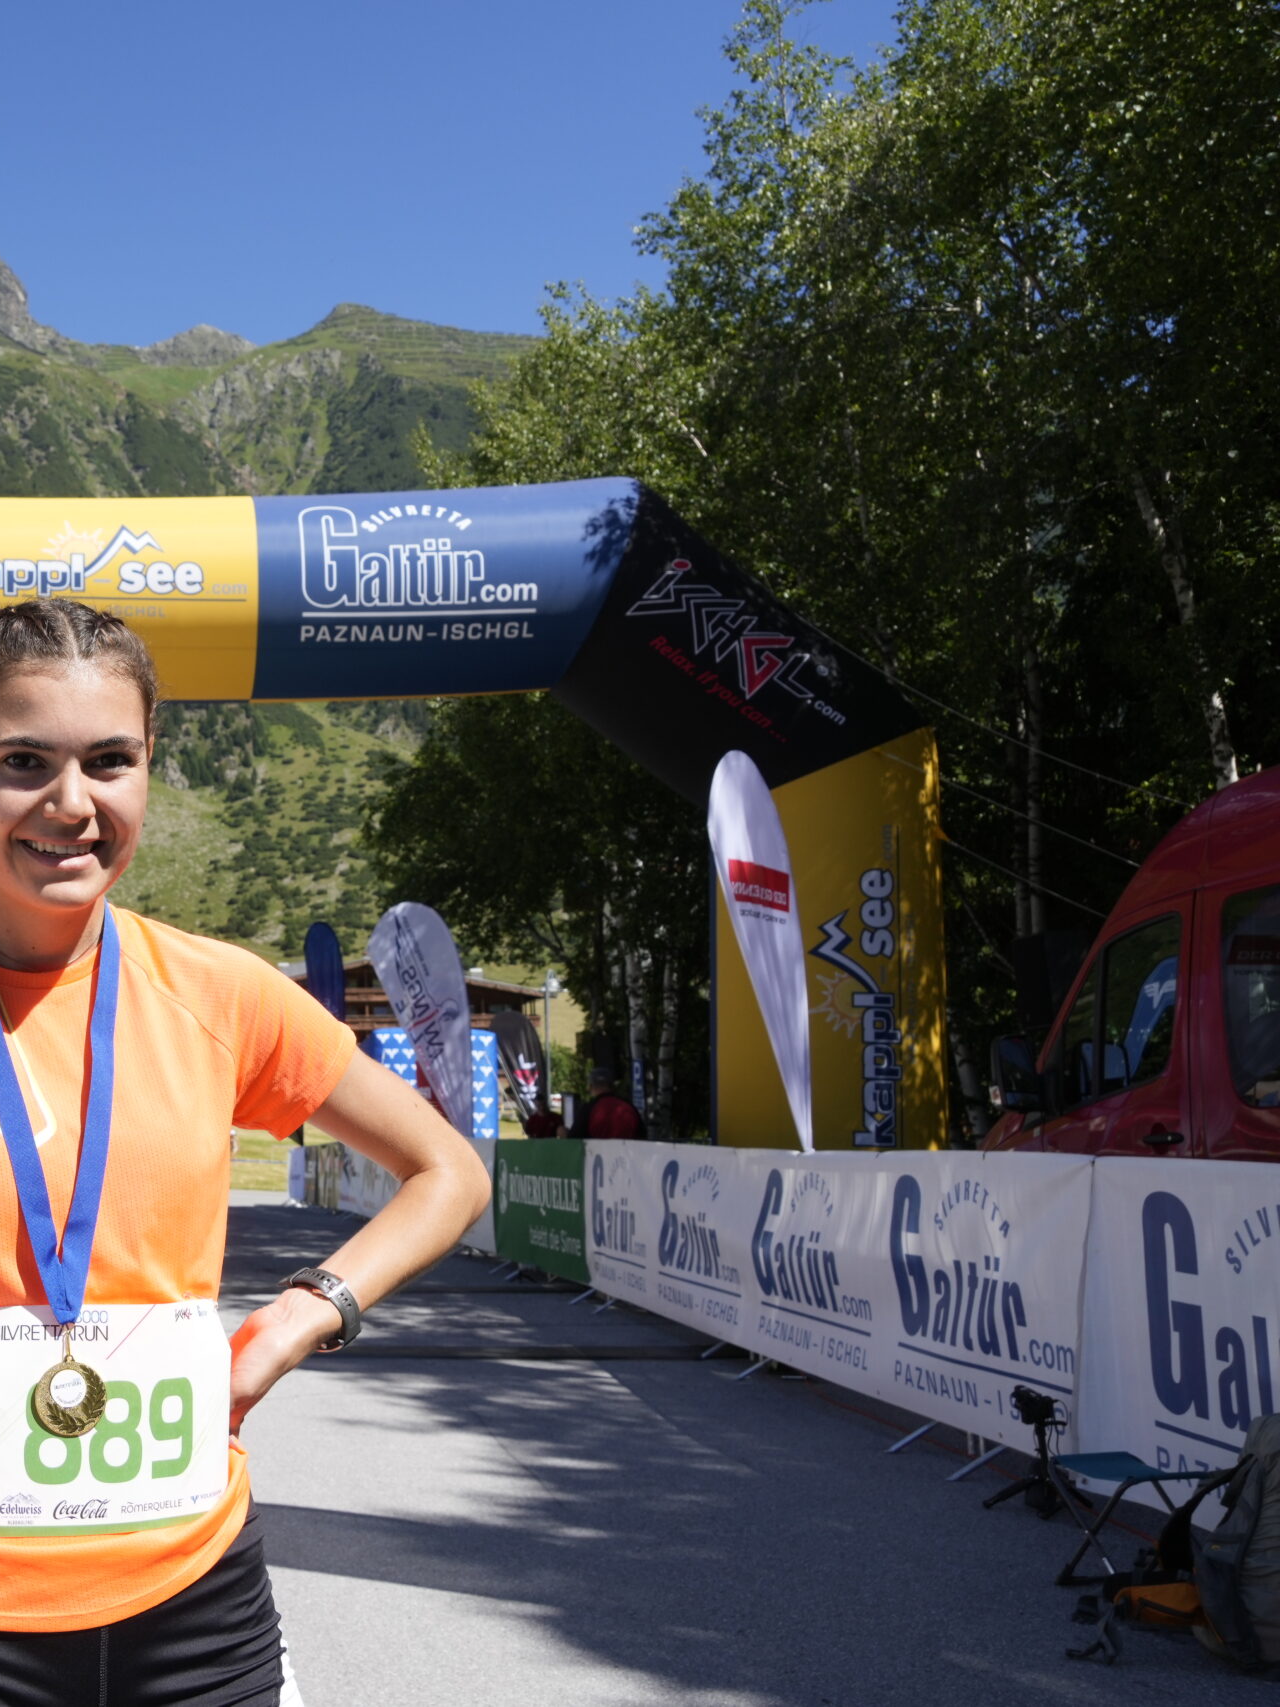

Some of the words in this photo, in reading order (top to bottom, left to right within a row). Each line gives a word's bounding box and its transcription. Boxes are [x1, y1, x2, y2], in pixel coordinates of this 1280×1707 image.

[361, 504, 472, 533] SILVRETTA
[934, 1179, 1012, 1239] SILVRETTA
[23, 1376, 194, 1485] 889
[0, 1502, 42, 1515] Edelweiss
